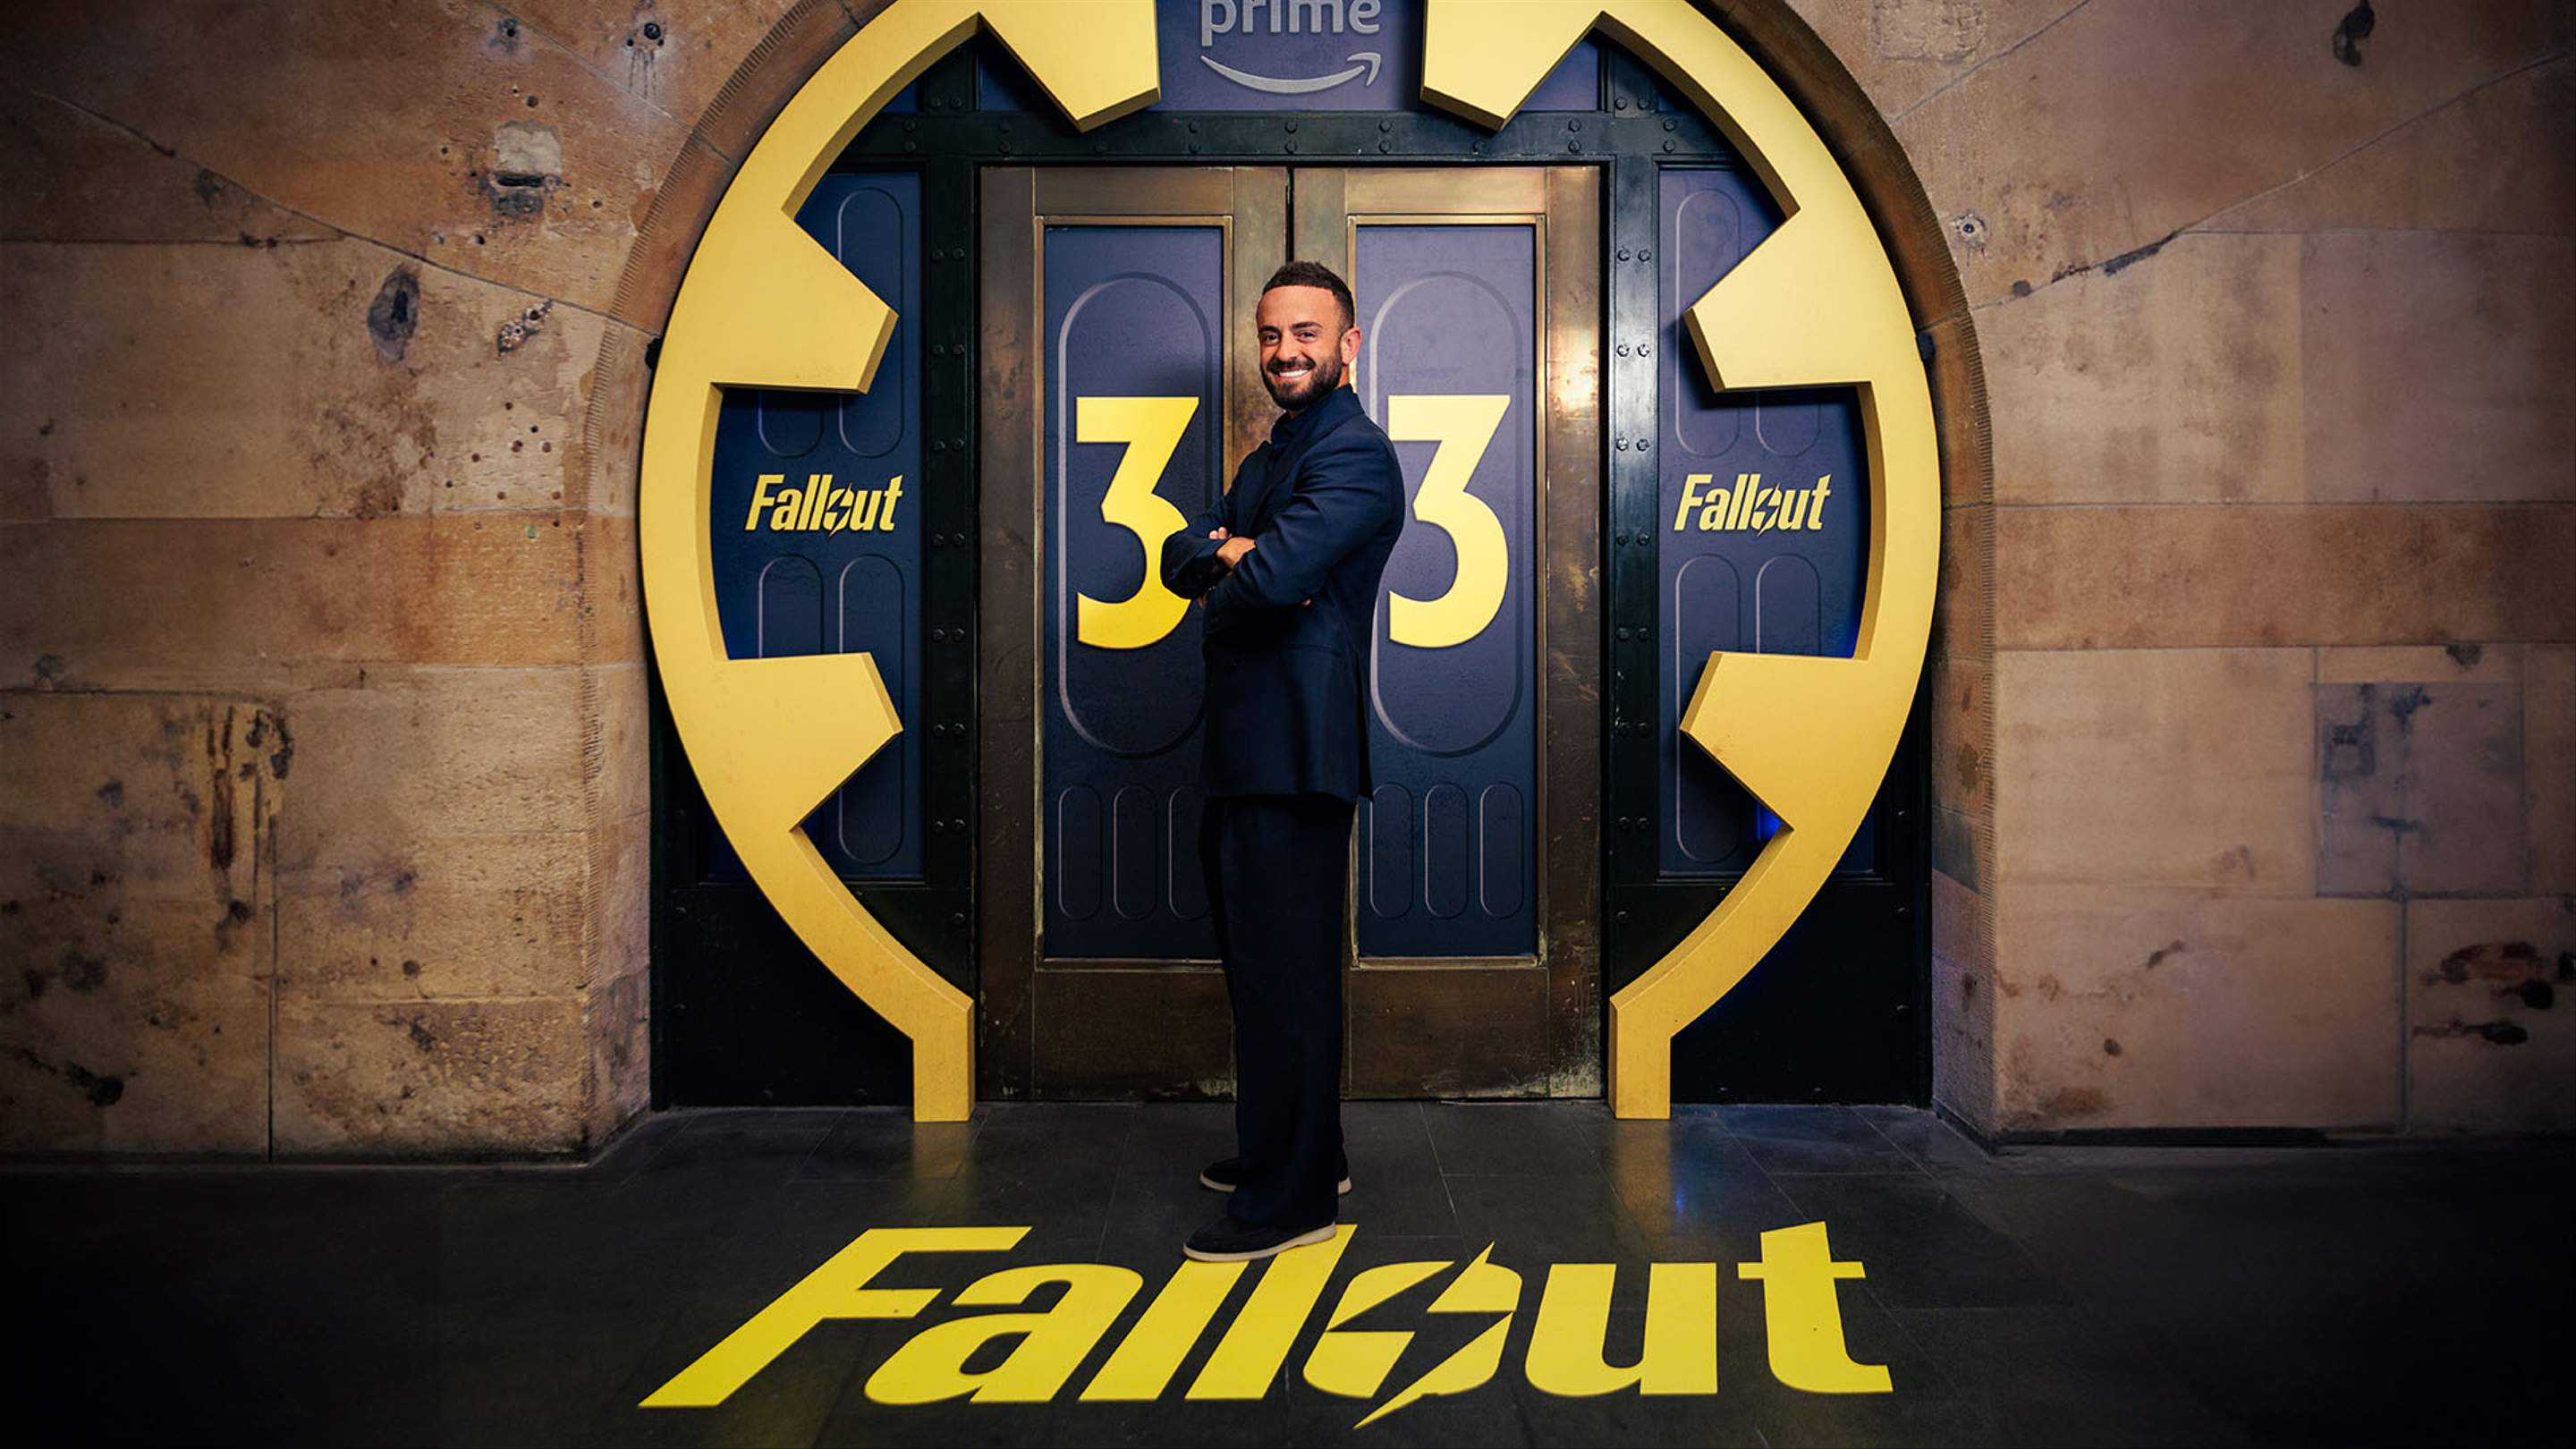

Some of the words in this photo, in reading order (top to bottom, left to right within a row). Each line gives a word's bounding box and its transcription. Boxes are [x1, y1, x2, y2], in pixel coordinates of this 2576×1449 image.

[1200, 0, 1381, 47] prime
[744, 474, 903, 537] Fallout
[1076, 395, 1199, 649] 3
[1387, 394, 1511, 648] 3
[1674, 474, 1832, 537] Fallout
[639, 1221, 1894, 1428] Fallout
